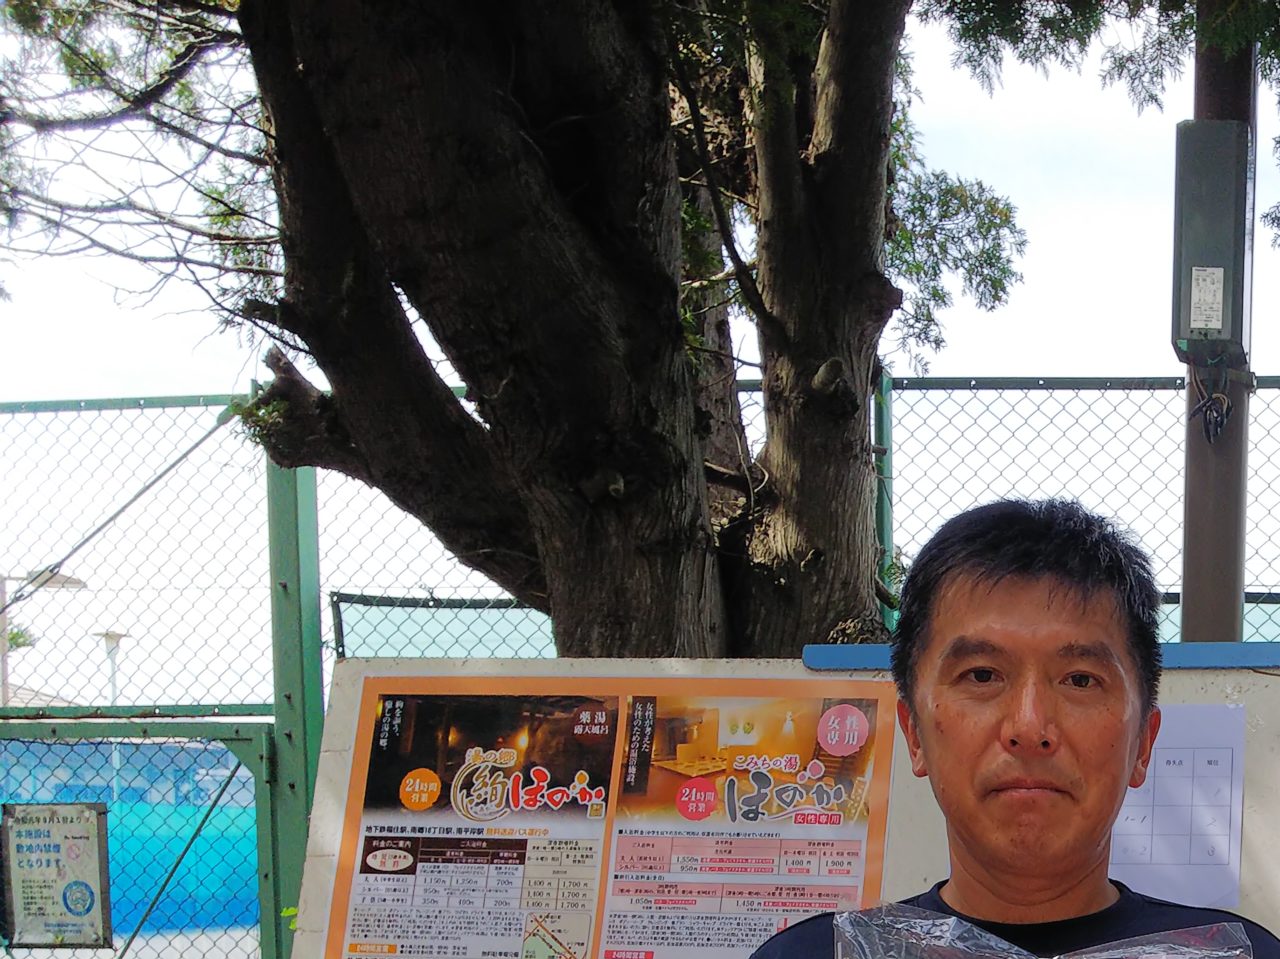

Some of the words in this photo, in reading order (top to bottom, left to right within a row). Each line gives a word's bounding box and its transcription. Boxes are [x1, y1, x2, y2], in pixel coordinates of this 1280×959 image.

[579, 711, 606, 724] 薬湯
[827, 715, 859, 730] 女性
[826, 731, 858, 746] 専用
[734, 755, 800, 771] こみちの湯
[405, 777, 438, 792] 24時間
[680, 787, 715, 802] 24時間
[726, 771, 844, 823] ほのか
[795, 814, 841, 825] 女性専用
